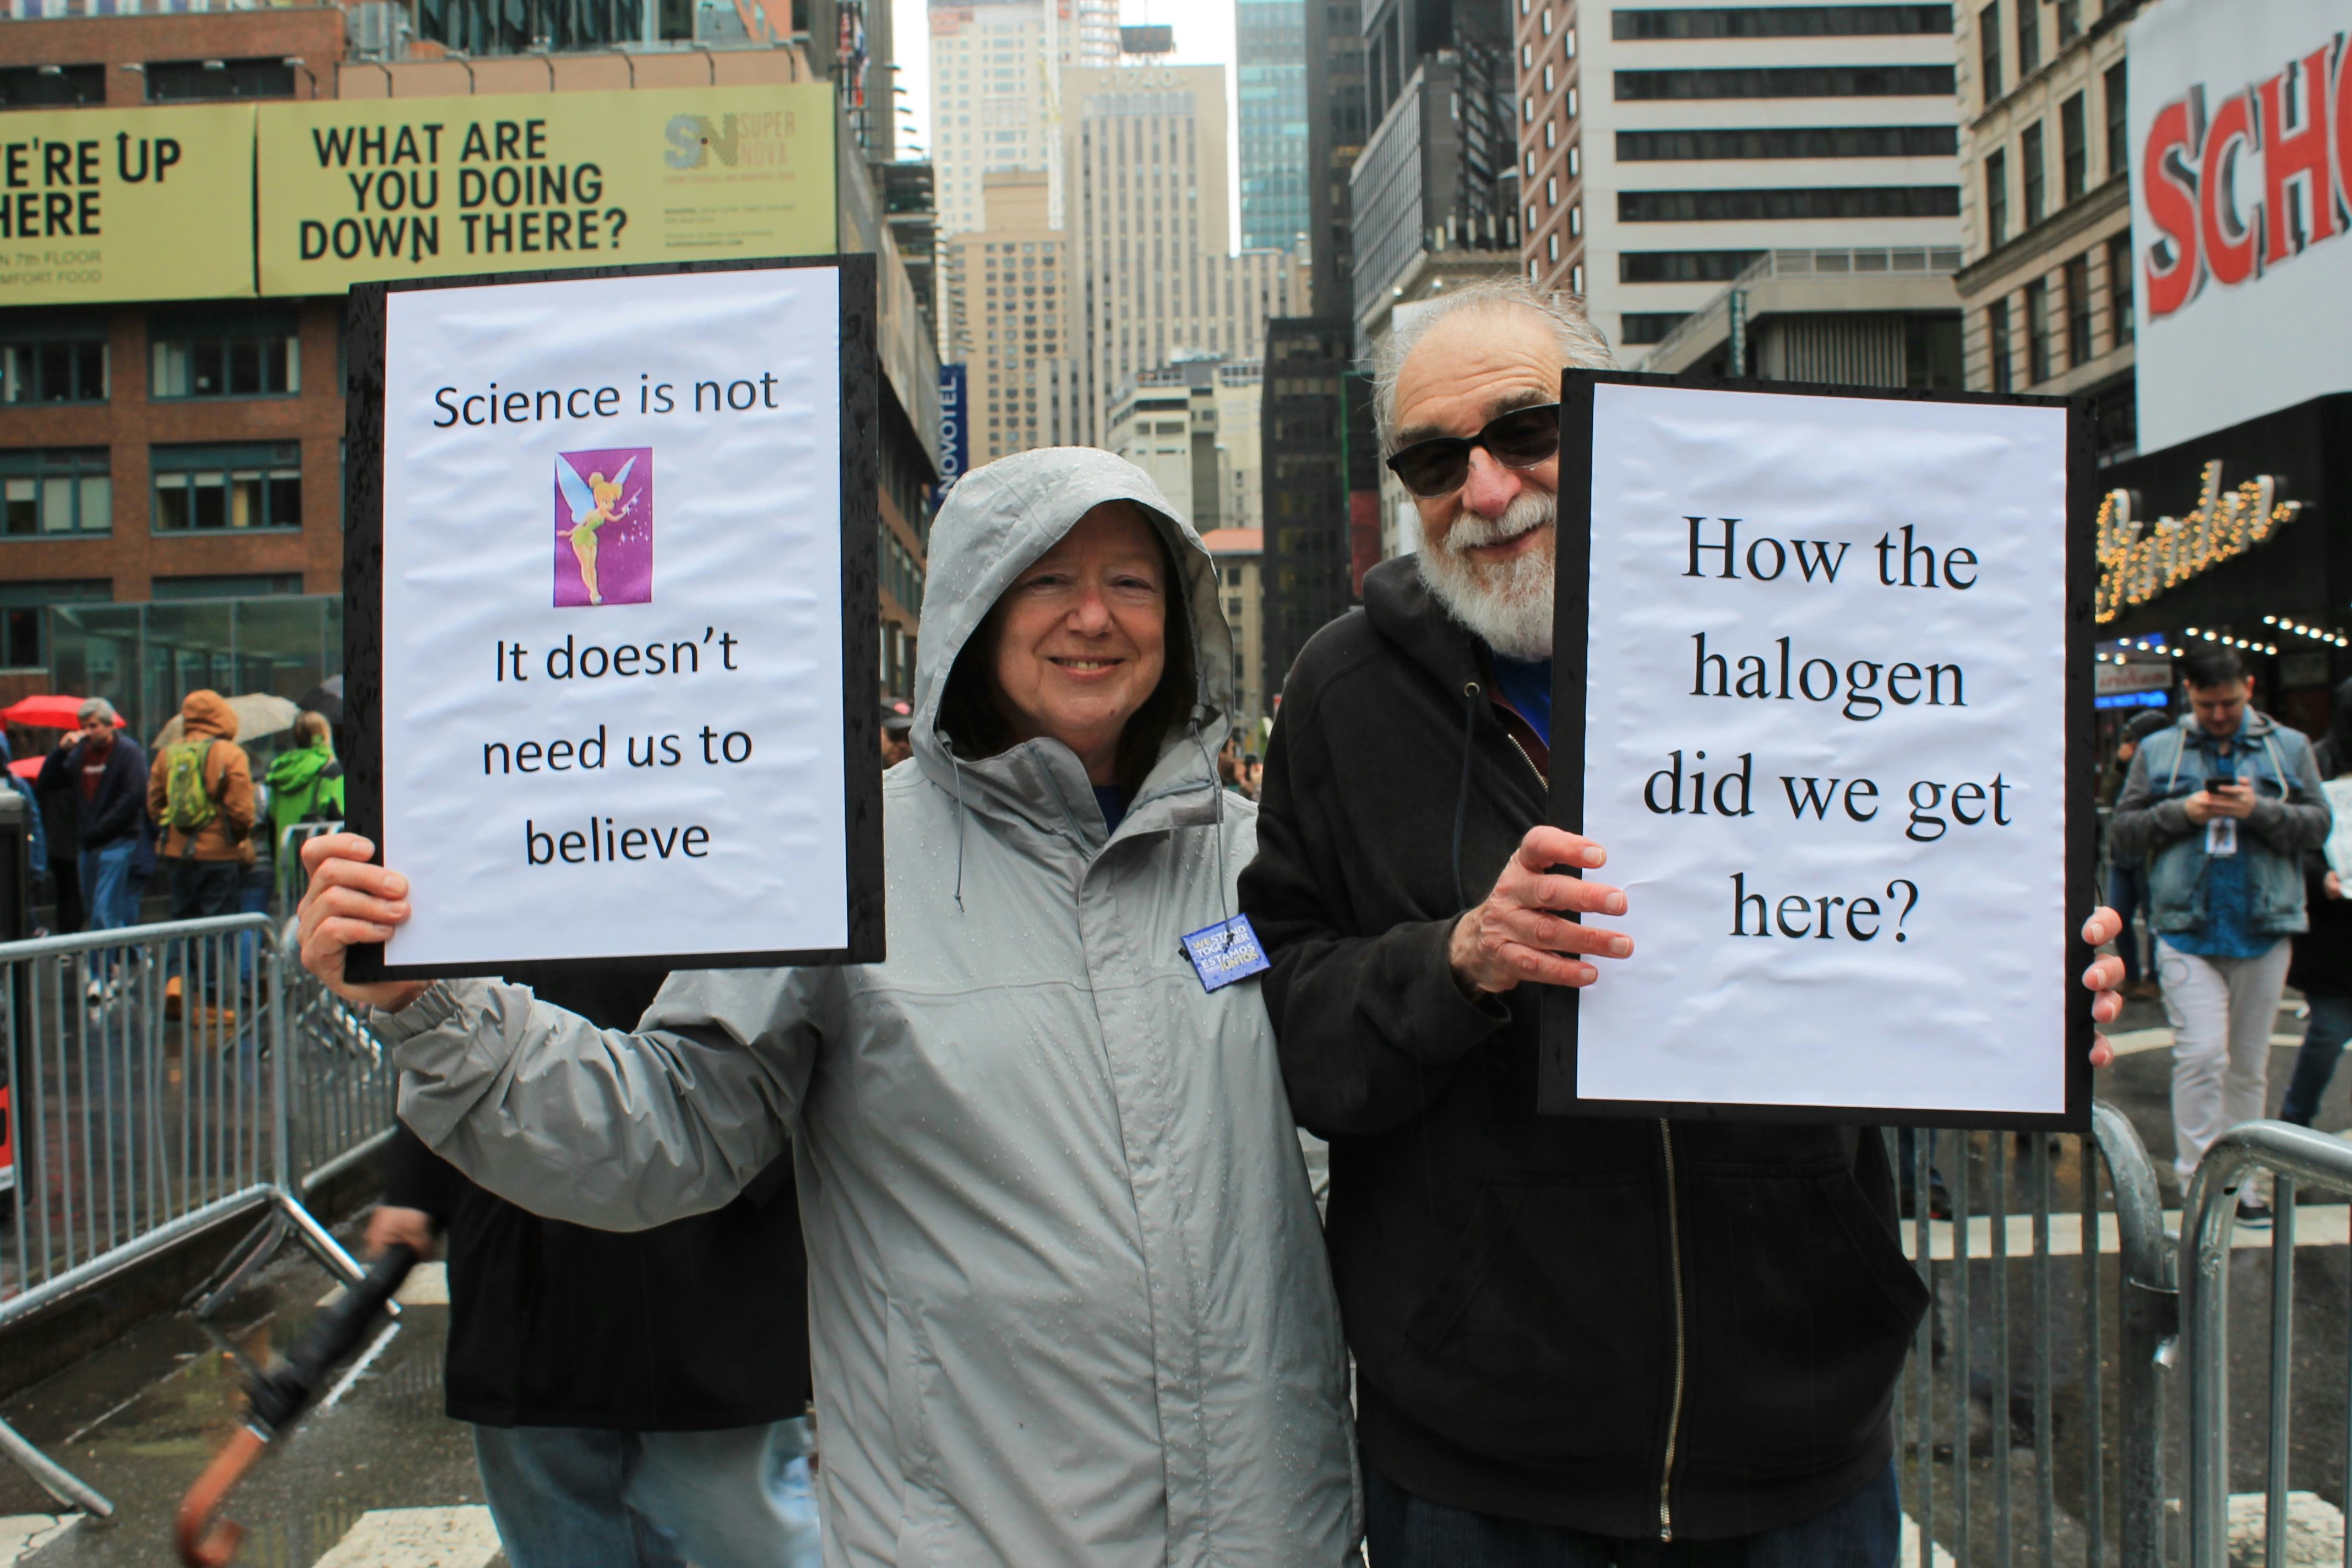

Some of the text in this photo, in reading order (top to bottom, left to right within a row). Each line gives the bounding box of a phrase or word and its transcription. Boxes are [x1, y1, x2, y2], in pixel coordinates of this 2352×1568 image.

[312, 119, 546, 168] WHAT ARE
[738, 111, 796, 139] SUPER
[0, 131, 182, 188] E'RE UP
[740, 140, 787, 167] NOVA
[2143, 30, 2352, 324] SCH
[348, 163, 602, 213] YOU DOING
[45, 249, 101, 265] FLOOR
[300, 208, 628, 264] DOWN THERE?
[57, 269, 102, 283] FOOD
[433, 372, 778, 428] Science is not
[937, 375, 959, 498] NOVOTEL
[1682, 516, 1978, 590] How the
[497, 626, 738, 682] It doesn’t
[1689, 631, 1966, 722] halogen
[483, 724, 752, 775] need us to
[1643, 749, 2011, 843] did we get
[526, 816, 710, 865] believe
[1730, 872, 1919, 943] here?
[1196, 933, 1250, 957] TOGEHER
[1201, 943, 1255, 968] ESTAMOS
[1220, 951, 1259, 972] JUNTOS
